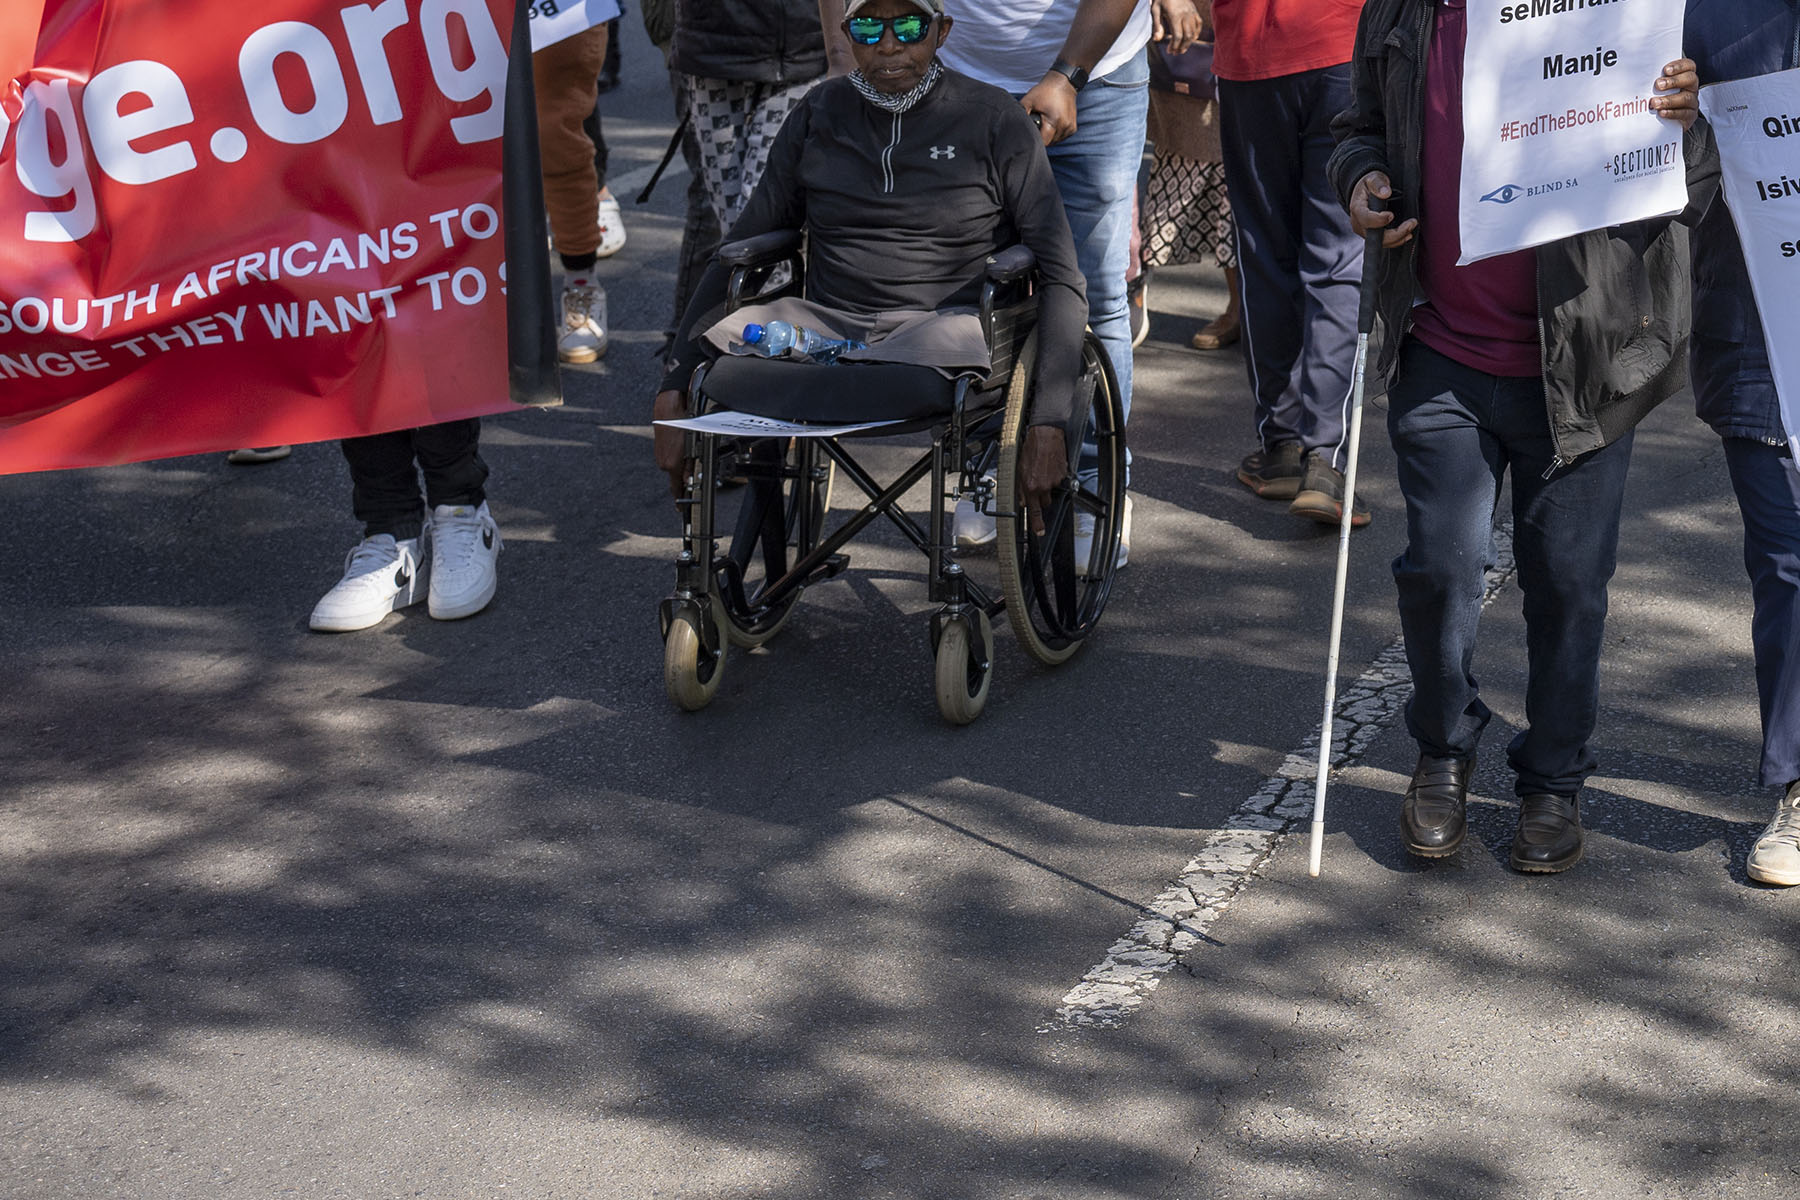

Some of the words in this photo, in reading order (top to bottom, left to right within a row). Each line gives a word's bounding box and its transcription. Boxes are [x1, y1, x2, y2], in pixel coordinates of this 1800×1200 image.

[1543, 47, 1618, 80] Manje
[1500, 95, 1648, 142] #EndTheBookFamin
[1604, 142, 1677, 175] +SECTION27
[1527, 180, 1562, 197] BLIND
[1565, 178, 1579, 189] SA
[172, 221, 419, 307] AFRICANS
[430, 202, 499, 248] TO
[111, 305, 249, 358] THEY
[258, 285, 402, 340] WANT
[415, 266, 487, 311] TO
